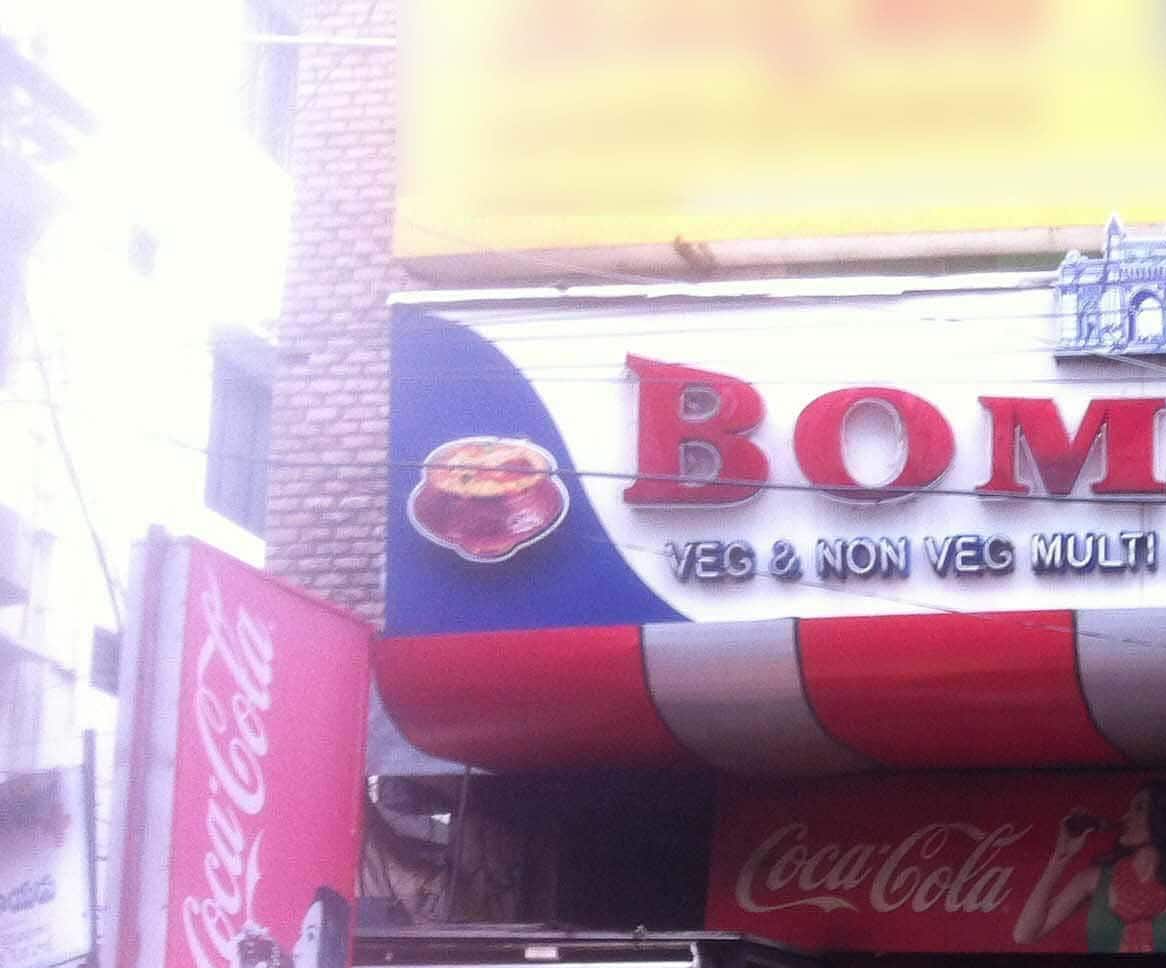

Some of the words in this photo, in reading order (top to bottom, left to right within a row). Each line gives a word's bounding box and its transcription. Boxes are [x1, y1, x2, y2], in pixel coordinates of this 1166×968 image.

[667, 539, 756, 581] VEG
[769, 539, 801, 578] &
[815, 536, 910, 578] NON
[923, 534, 1015, 575] VEG
[1031, 531, 1157, 575] MULTI
[735, 823, 1033, 914] Coca-Cola
